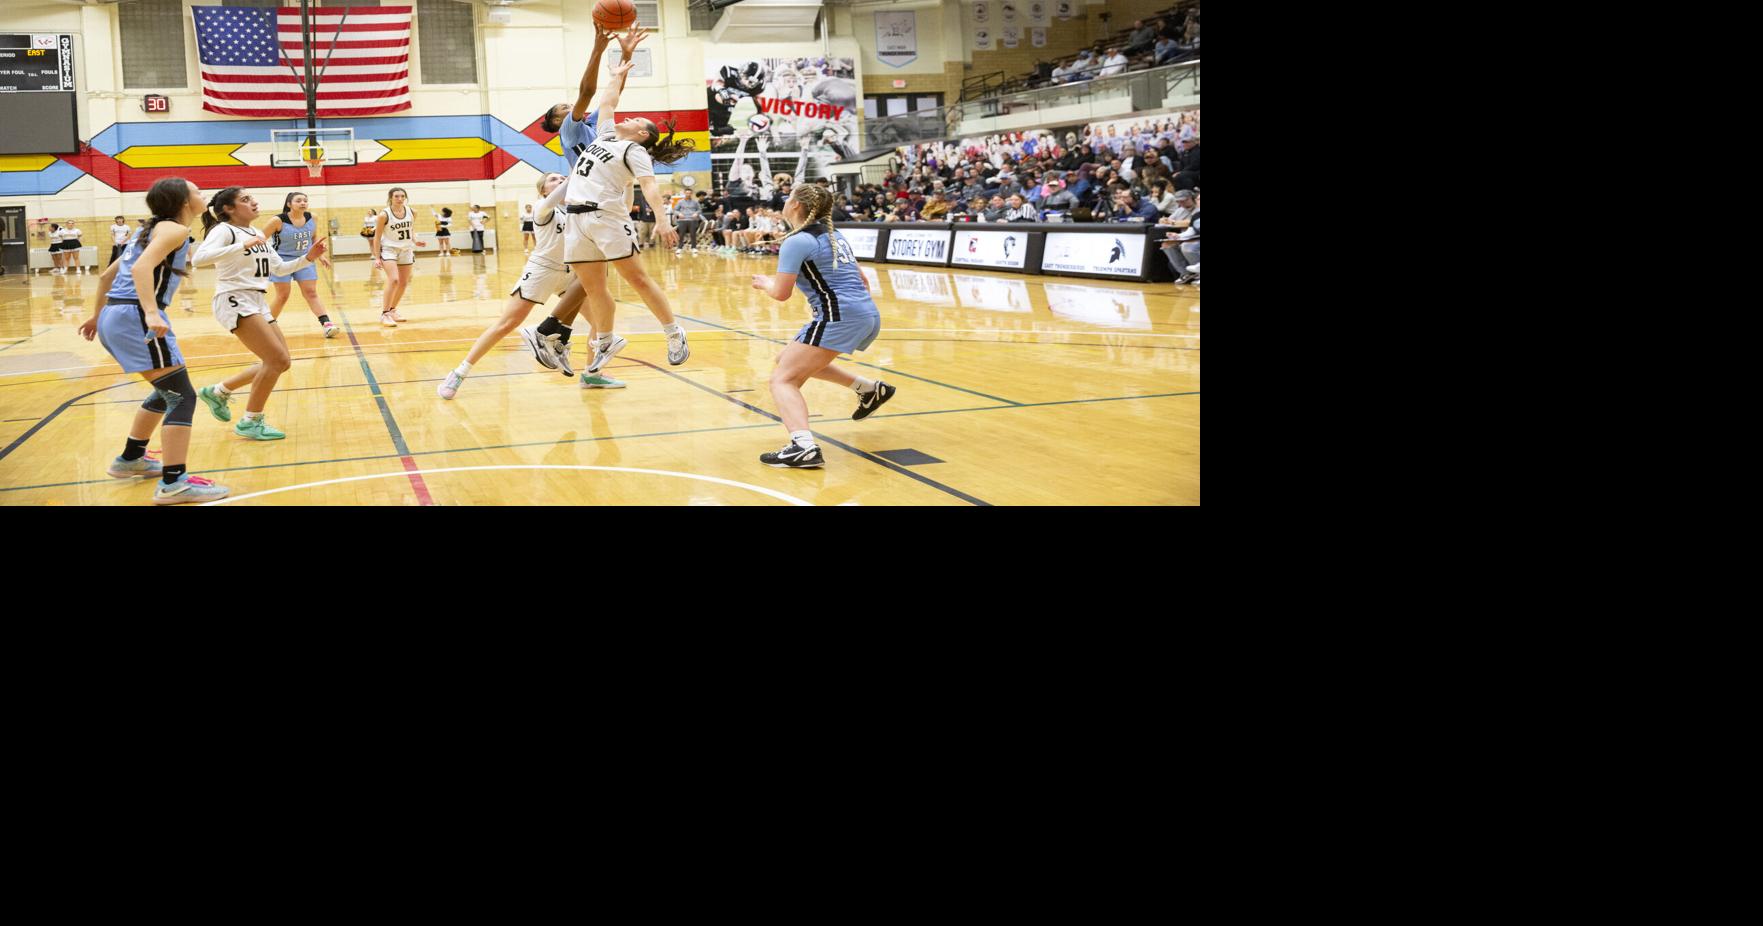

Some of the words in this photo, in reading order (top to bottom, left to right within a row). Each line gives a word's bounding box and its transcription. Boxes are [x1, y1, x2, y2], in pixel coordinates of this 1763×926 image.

[27, 49, 46, 57] EAST
[61, 38, 73, 88] GYMNASIUM
[148, 98, 166, 111] 30
[759, 97, 845, 121] VICTORY
[576, 157, 595, 178] 13
[390, 221, 413, 231] SOUT
[556, 223, 566, 234] S
[623, 224, 633, 237] S
[293, 230, 312, 240] EAST
[397, 230, 411, 241] 31
[296, 239, 309, 251] 12
[891, 239, 924, 257] STOREY
[925, 240, 946, 260] GYM
[254, 258, 270, 278] 10
[228, 295, 239, 308] S
